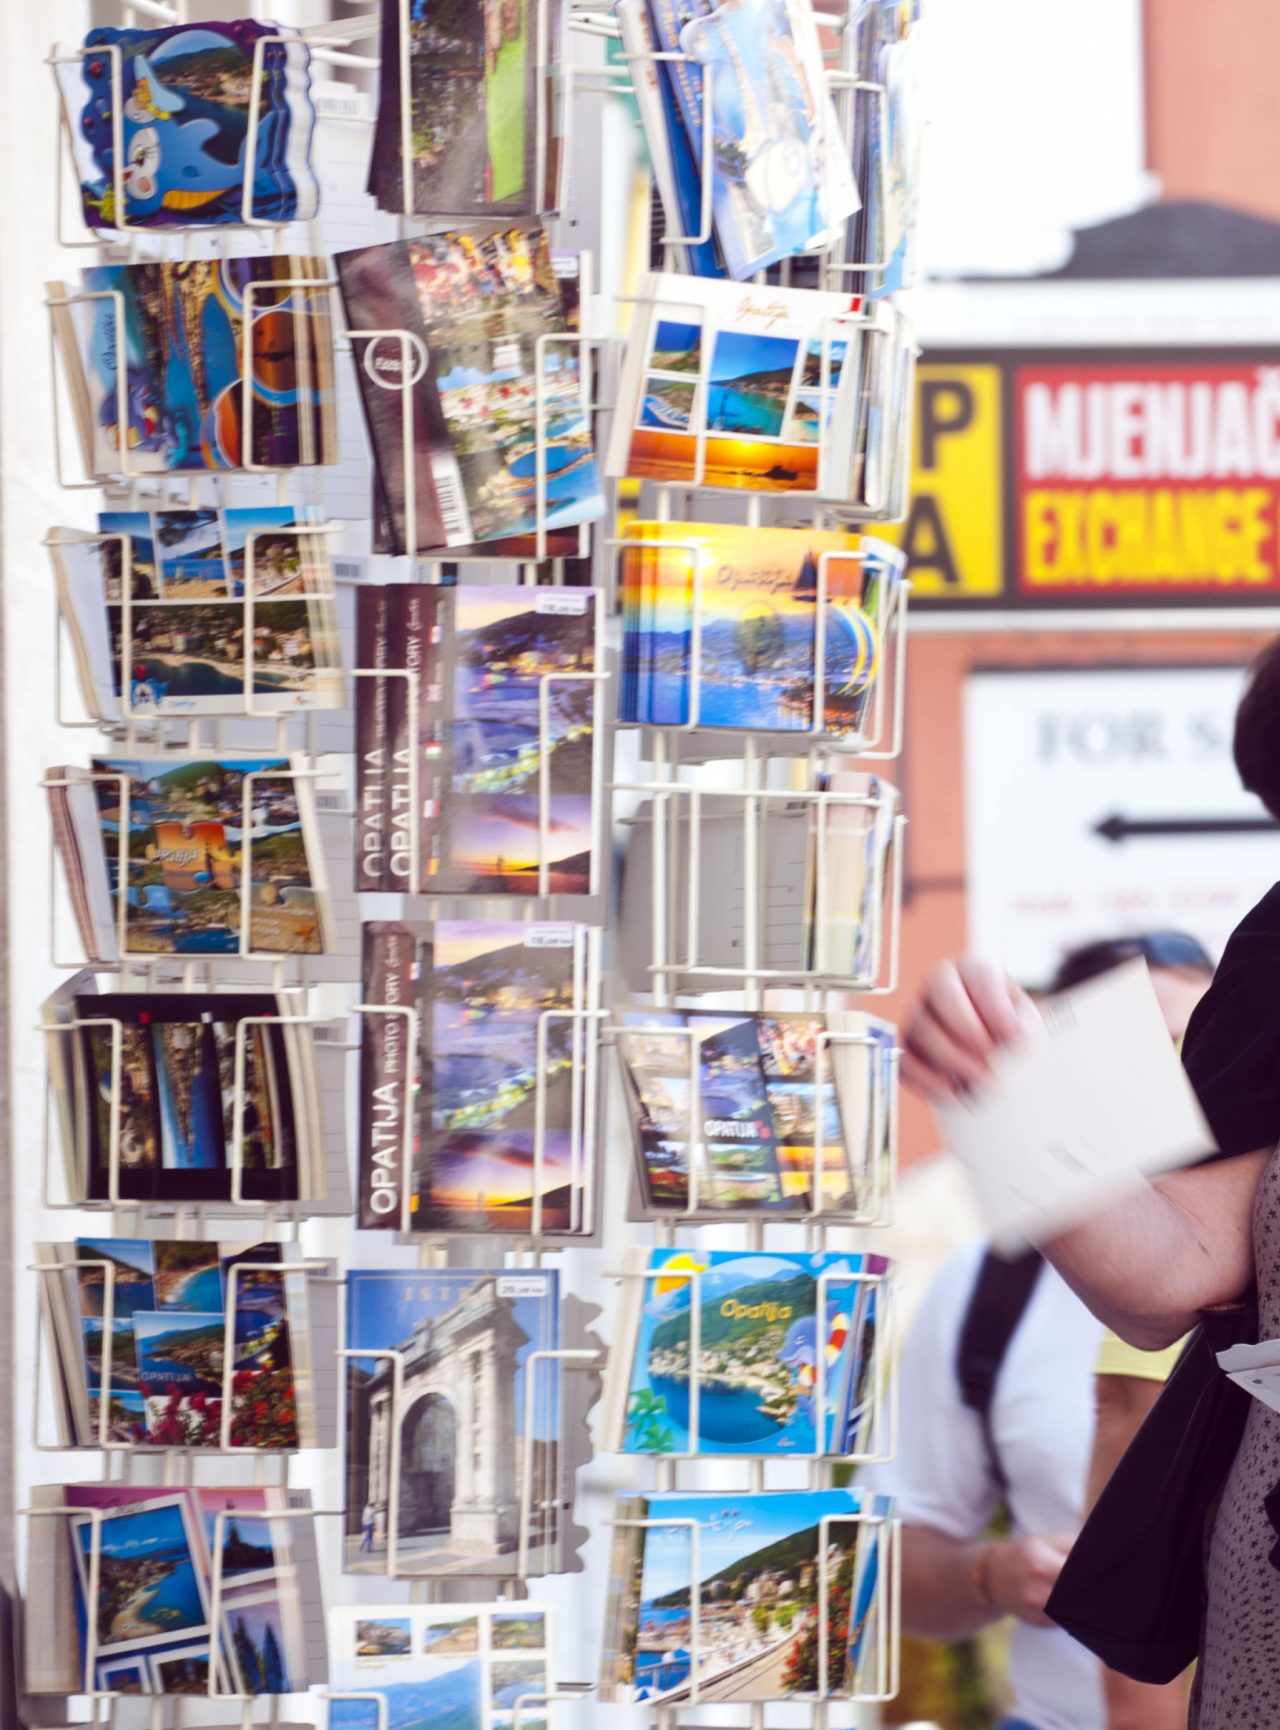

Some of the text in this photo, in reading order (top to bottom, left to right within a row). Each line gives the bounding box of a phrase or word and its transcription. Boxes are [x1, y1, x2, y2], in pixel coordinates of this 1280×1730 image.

[1026, 488, 1272, 585] EXCHANGE
[1038, 710, 1168, 765] FOR
[384, 1022, 400, 1073] PHOTO
[370, 1081, 399, 1214] OPATIJA
[703, 1120, 759, 1138] OPATIJA
[721, 1299, 793, 1322] Opatija
